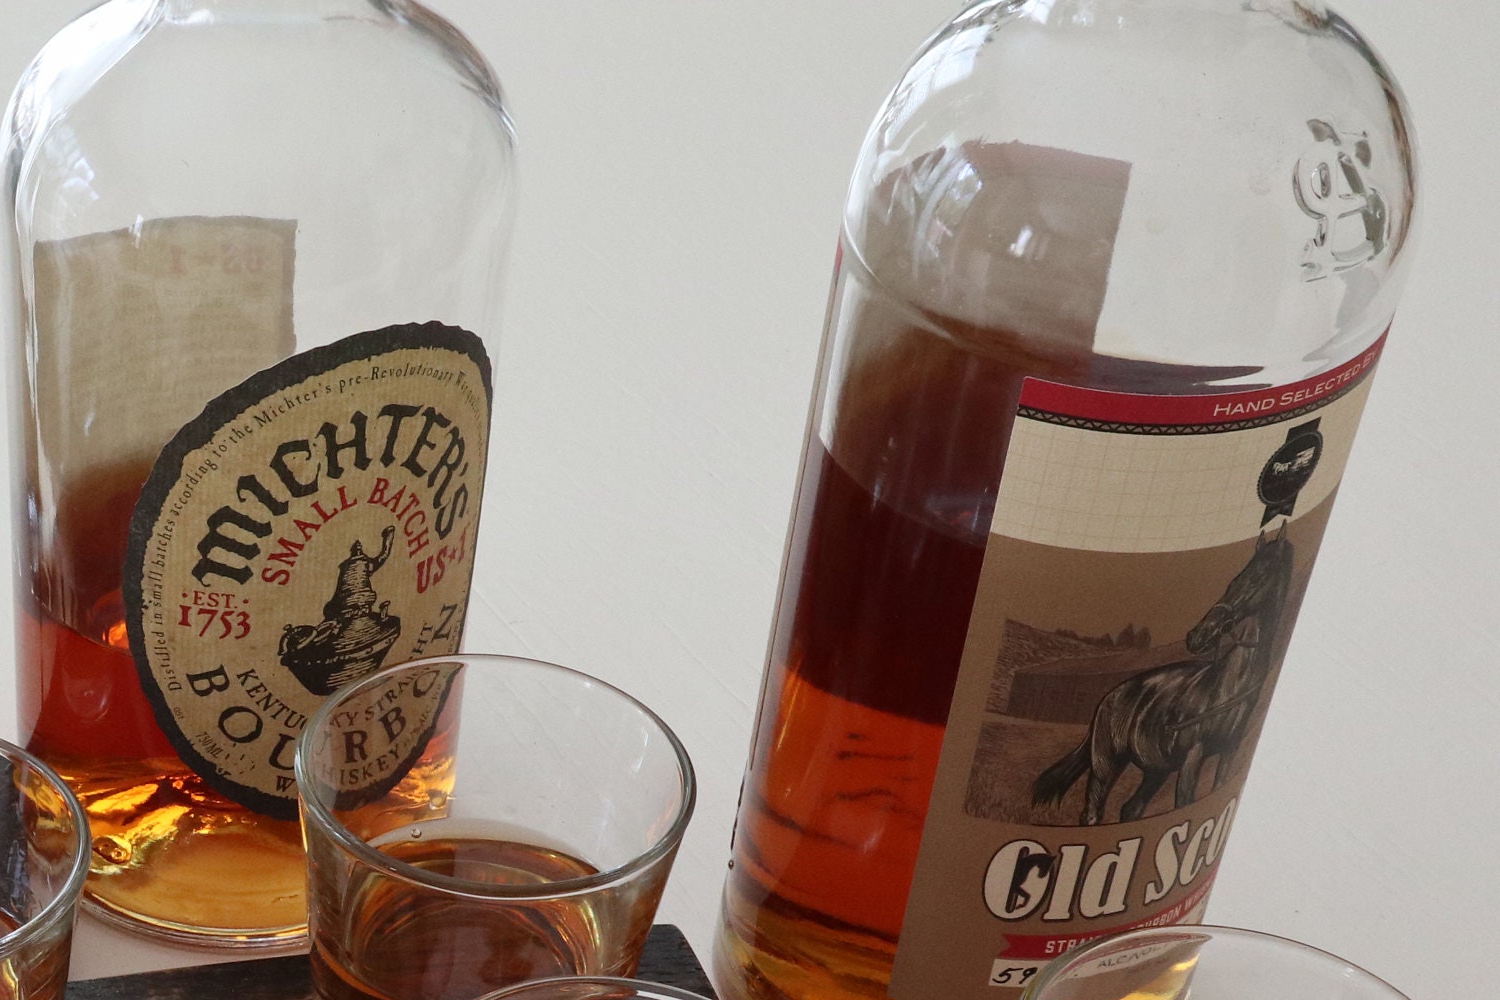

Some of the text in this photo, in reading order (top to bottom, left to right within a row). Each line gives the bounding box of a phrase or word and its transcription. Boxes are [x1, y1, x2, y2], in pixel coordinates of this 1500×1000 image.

[338, 362, 454, 393] pre-Revolutionary
[1212, 398, 1275, 417] HAND
[1279, 363, 1361, 406] SELECTED
[253, 383, 332, 428] Michter's
[212, 444, 228, 458] to
[229, 425, 253, 445] the
[171, 458, 219, 516] according
[191, 404, 469, 587] MICHTER'S
[156, 519, 175, 569] batches
[261, 477, 430, 586] SMALL BATCH
[153, 569, 164, 606] small
[193, 591, 238, 609] EST.
[150, 612, 163, 625] in
[178, 604, 252, 640] 1753
[153, 631, 182, 691] Distilled
[364, 621, 434, 721] STRAIHT
[982, 836, 1143, 922] Old
